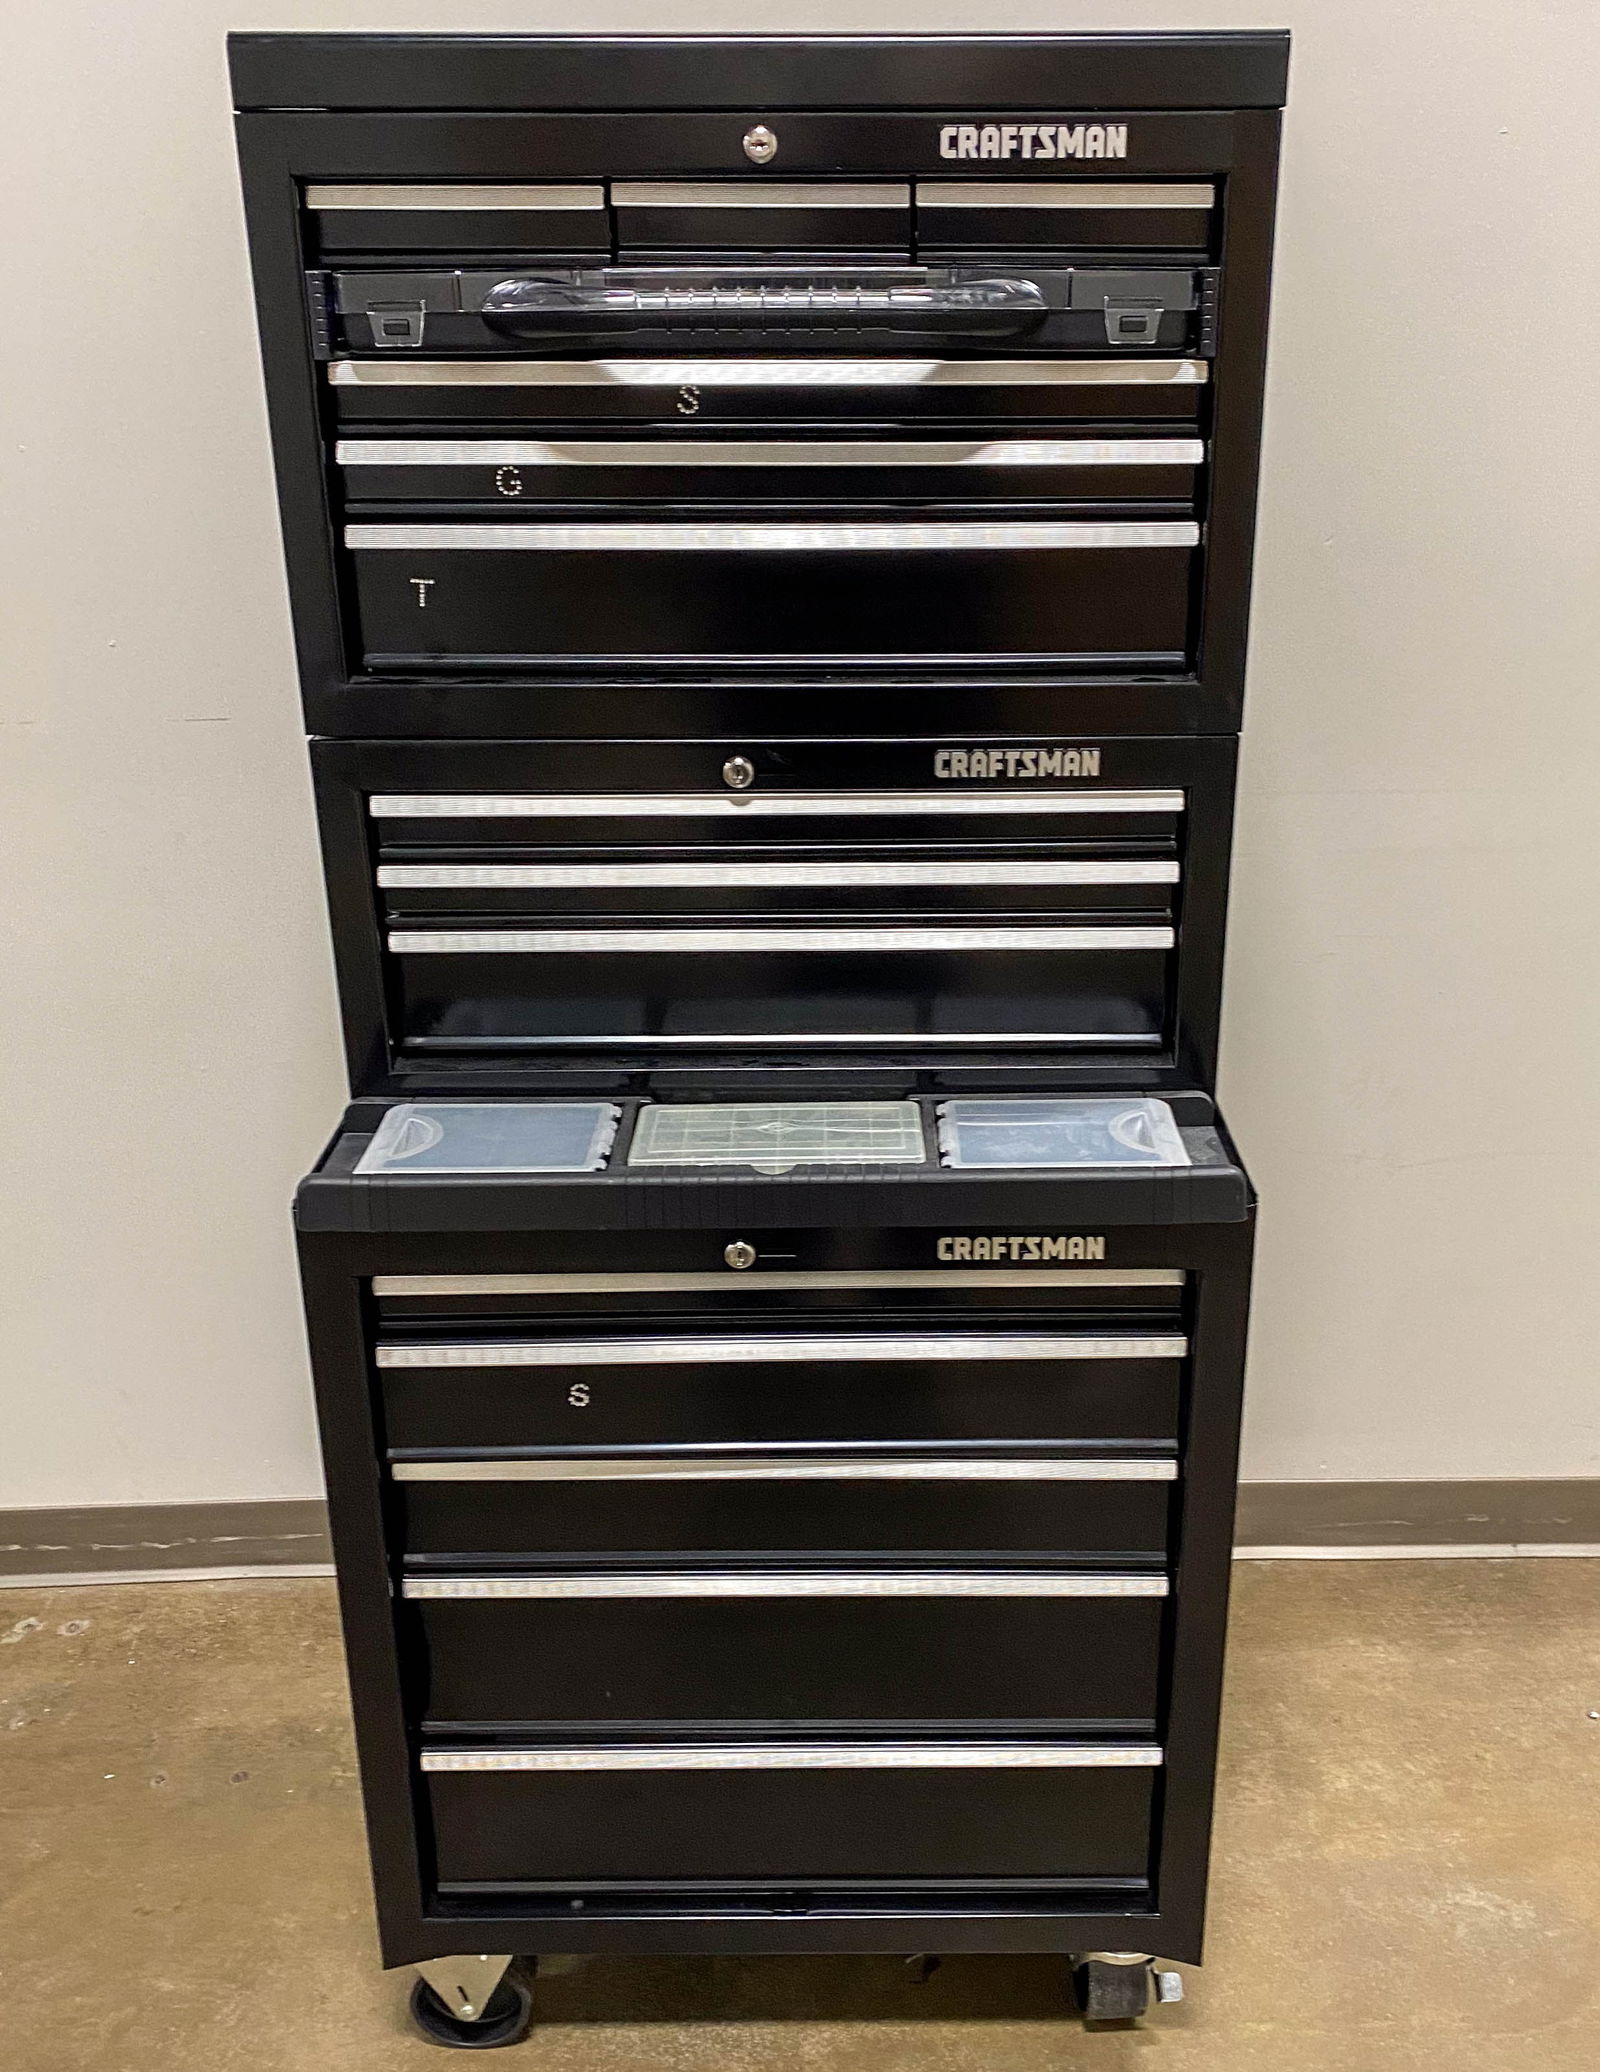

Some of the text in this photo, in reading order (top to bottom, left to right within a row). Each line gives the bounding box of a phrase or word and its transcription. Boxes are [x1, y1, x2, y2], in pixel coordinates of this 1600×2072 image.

[939, 124, 1127, 160] CRAFTSMAN
[676, 385, 701, 415] S
[495, 465, 524, 496] G
[409, 578, 436, 608] T
[934, 748, 1101, 778] CRAFTSMAN
[937, 1236, 1105, 1261] CRAFTSMAN
[567, 1383, 591, 1408] S
